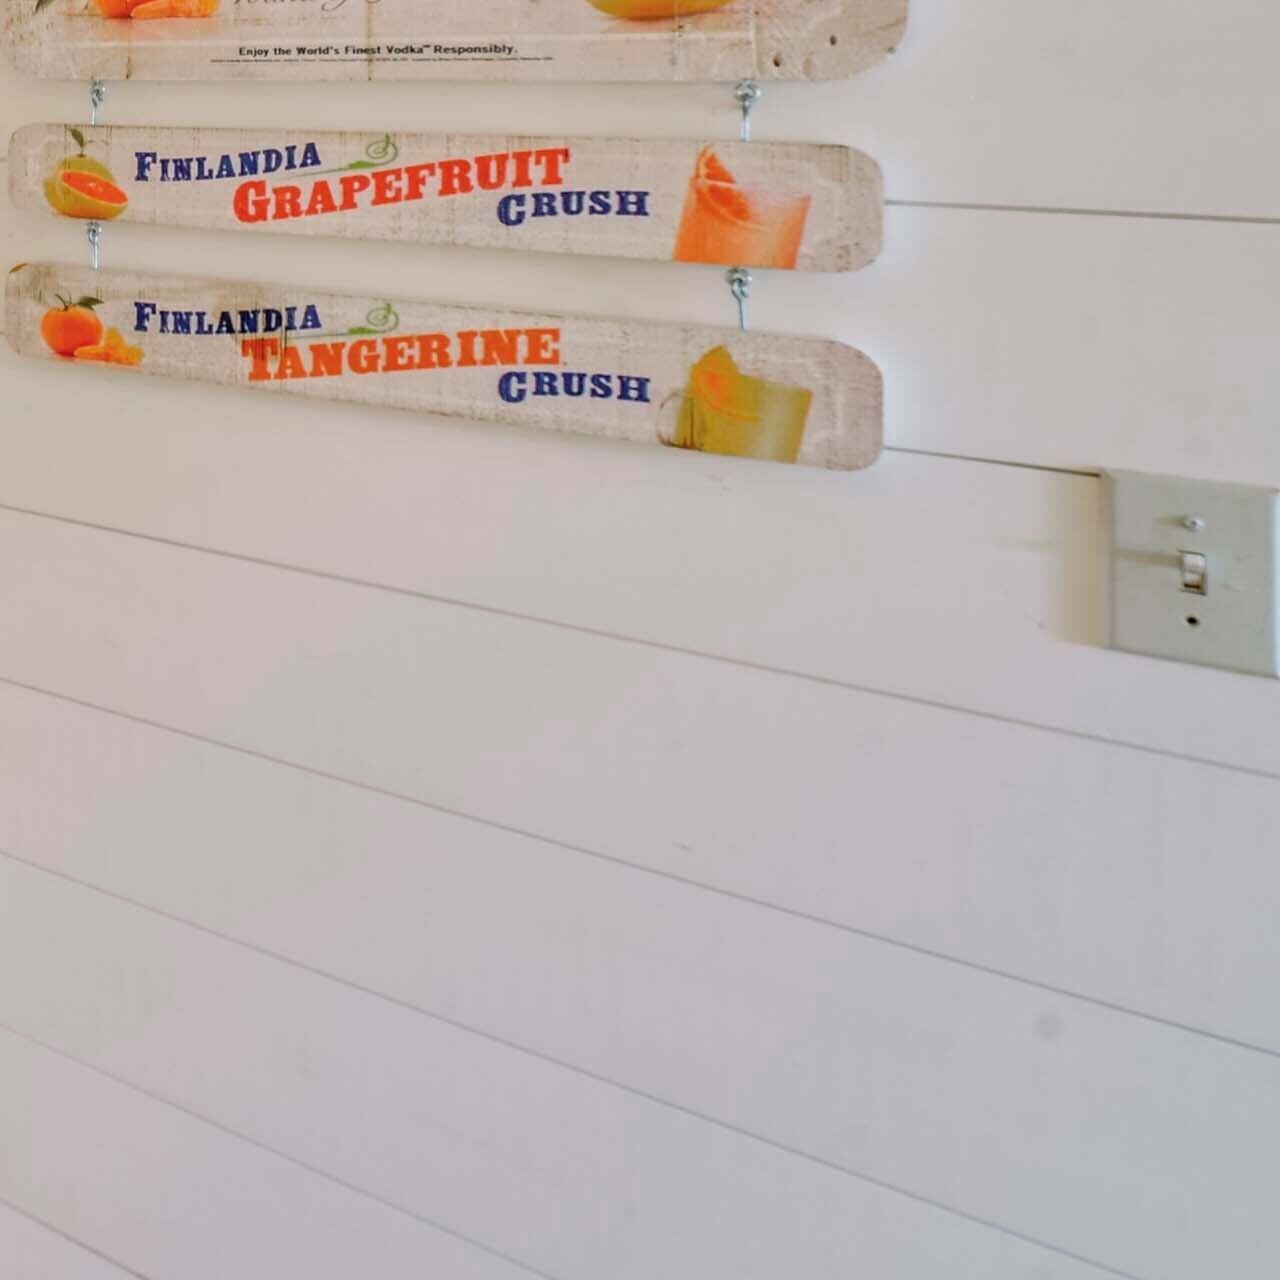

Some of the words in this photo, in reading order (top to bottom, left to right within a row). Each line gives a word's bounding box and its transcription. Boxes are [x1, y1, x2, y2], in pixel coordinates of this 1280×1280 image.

[239, 47, 269, 57] Enjoy
[273, 46, 292, 56] the
[296, 46, 340, 56] World's
[345, 45, 381, 55] Finest
[434, 44, 518, 56] Responsibly.
[233, 148, 570, 223] GRAPEFRUIT
[497, 190, 650, 226] CRUSH
[241, 328, 561, 381] TANGERINE
[498, 371, 651, 403] CRUSH
